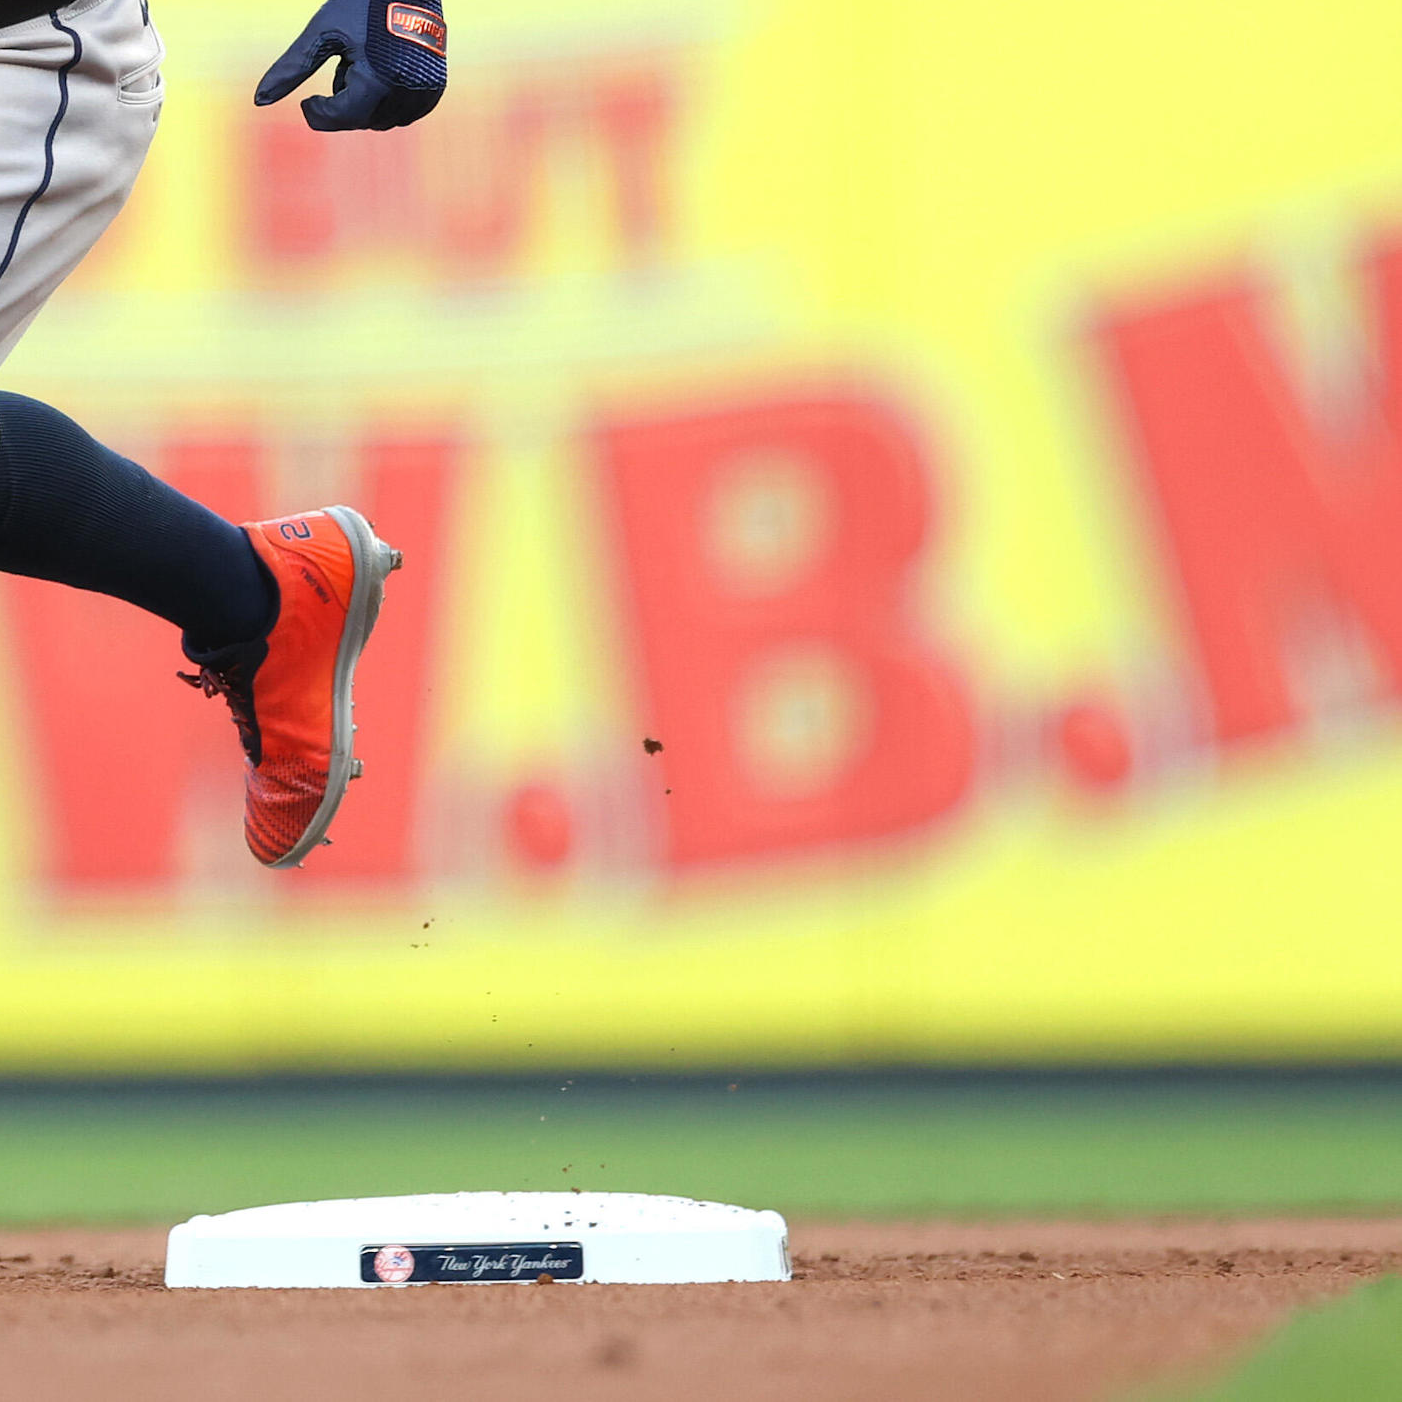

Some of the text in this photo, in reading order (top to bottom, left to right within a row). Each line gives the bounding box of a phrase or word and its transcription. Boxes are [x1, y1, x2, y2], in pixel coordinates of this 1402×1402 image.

[436, 1255, 471, 1272] New
[471, 1253, 508, 1278] York
[507, 1253, 573, 1278] Yankees
